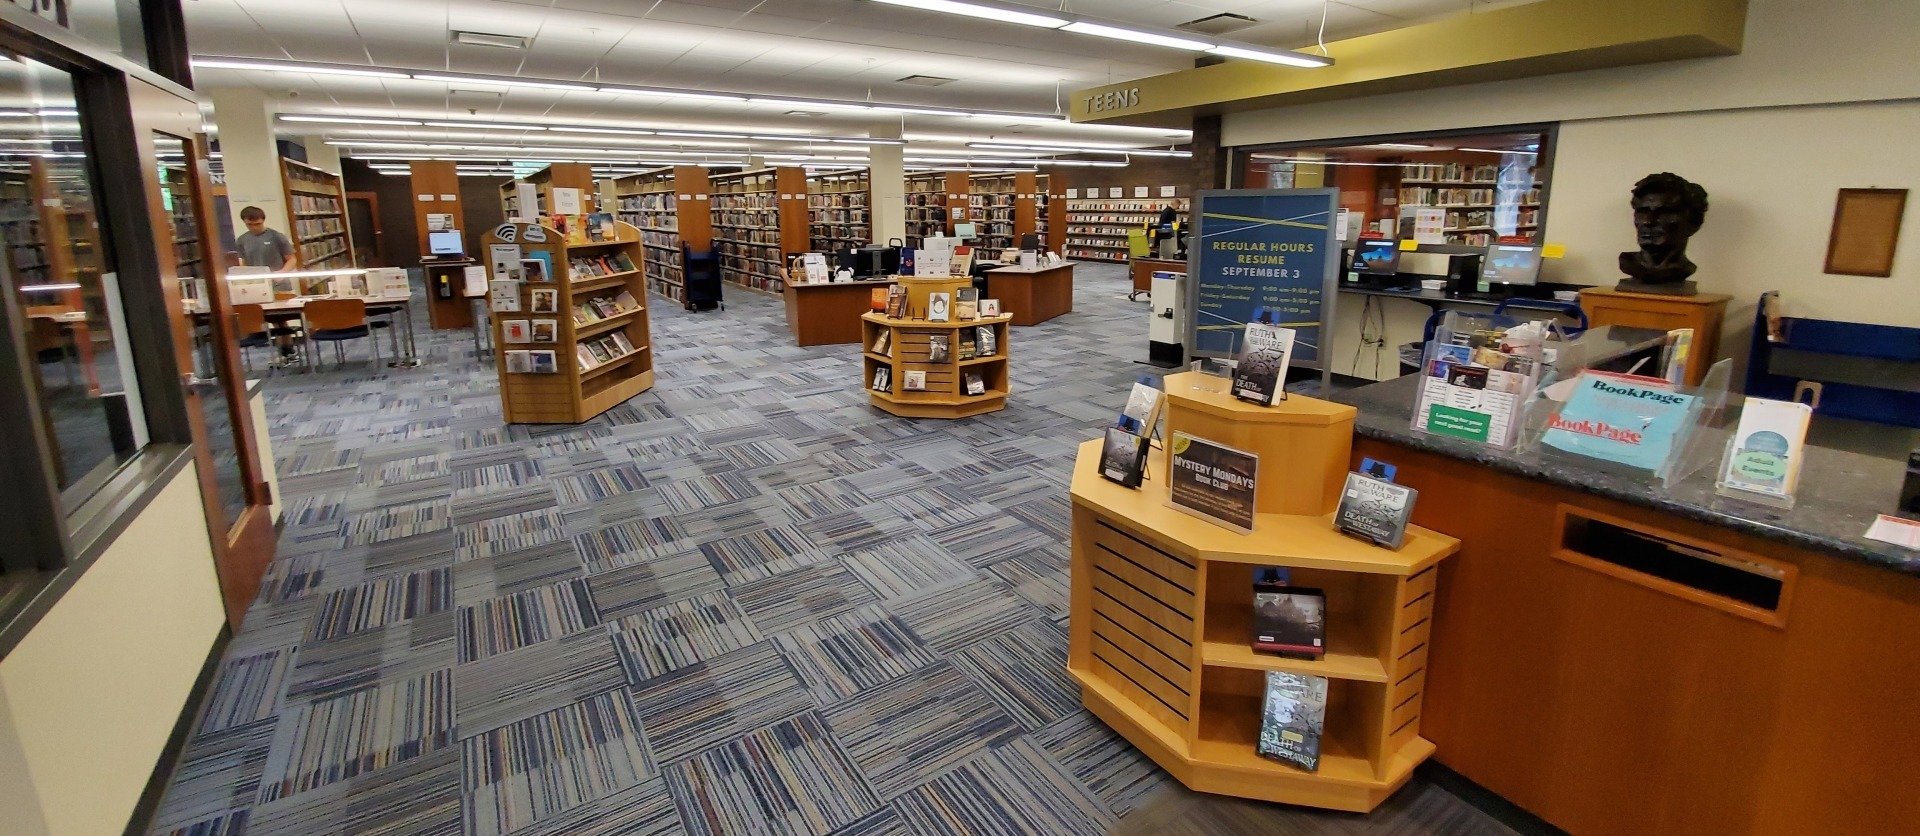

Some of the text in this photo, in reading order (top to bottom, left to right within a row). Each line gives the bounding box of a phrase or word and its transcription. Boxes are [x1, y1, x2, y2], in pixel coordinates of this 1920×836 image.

[1083, 88, 1140, 114] TEENS
[1213, 241, 1314, 253] REGULAR HOURS
[1237, 254, 1285, 265] RESUME
[1222, 266, 1300, 279] SEPTEMBER 3
[1250, 327, 1271, 339] RUTH
[1260, 338, 1282, 350] WARE
[1236, 379, 1257, 391] DEATH
[1592, 380, 1685, 405] BookPage
[1548, 411, 1642, 445] BookPage
[1747, 456, 1774, 466] Adult
[1174, 455, 1255, 489] MYSTERY MONDAYS
[1742, 464, 1775, 476] Events
[1358, 479, 1385, 492] RUTH
[1371, 489, 1399, 503] WARE
[1344, 510, 1373, 525] DEATH
